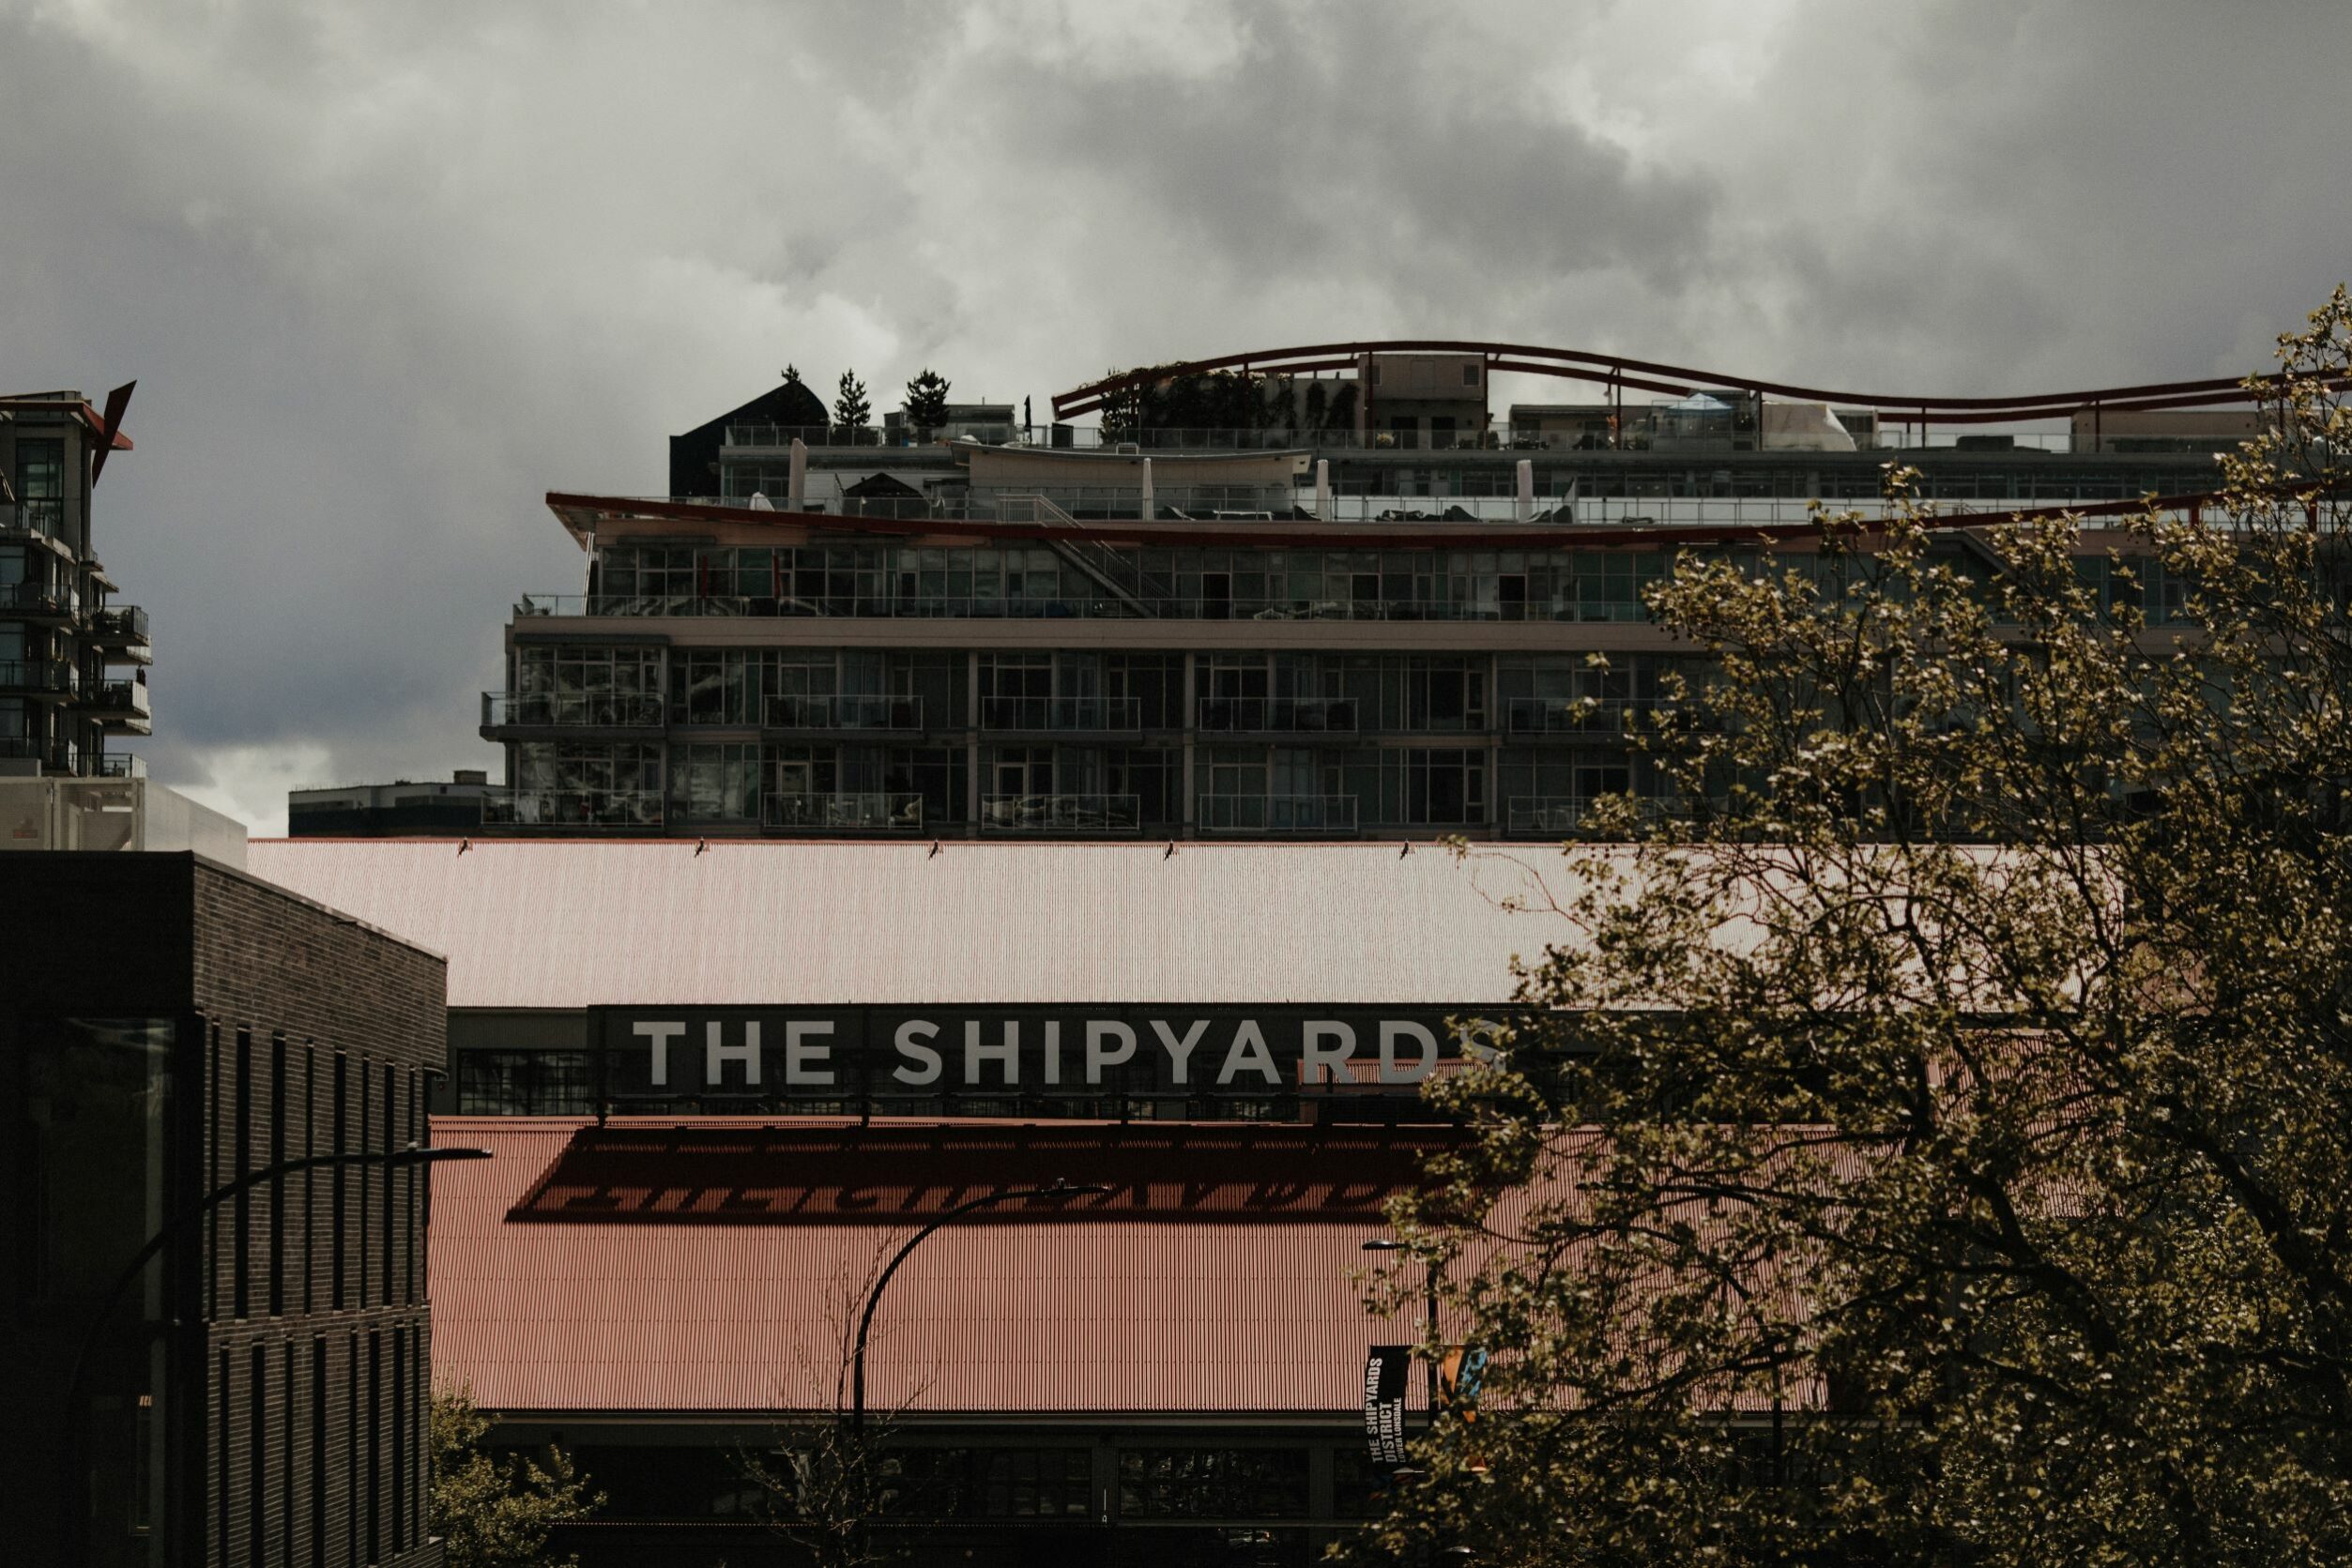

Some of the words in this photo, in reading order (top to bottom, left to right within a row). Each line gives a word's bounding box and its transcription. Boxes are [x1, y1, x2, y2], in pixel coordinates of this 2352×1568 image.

[633, 1020, 834, 1085] THE
[893, 1019, 1506, 1085] SHIPYARDS
[1366, 1358, 1382, 1435] SHIPYARDS
[1393, 1397, 1402, 1437] LONSDALE
[1368, 1438, 1383, 1463] THE
[1380, 1402, 1397, 1463] DISTRICT
[1395, 1438, 1406, 1463] LOWER
